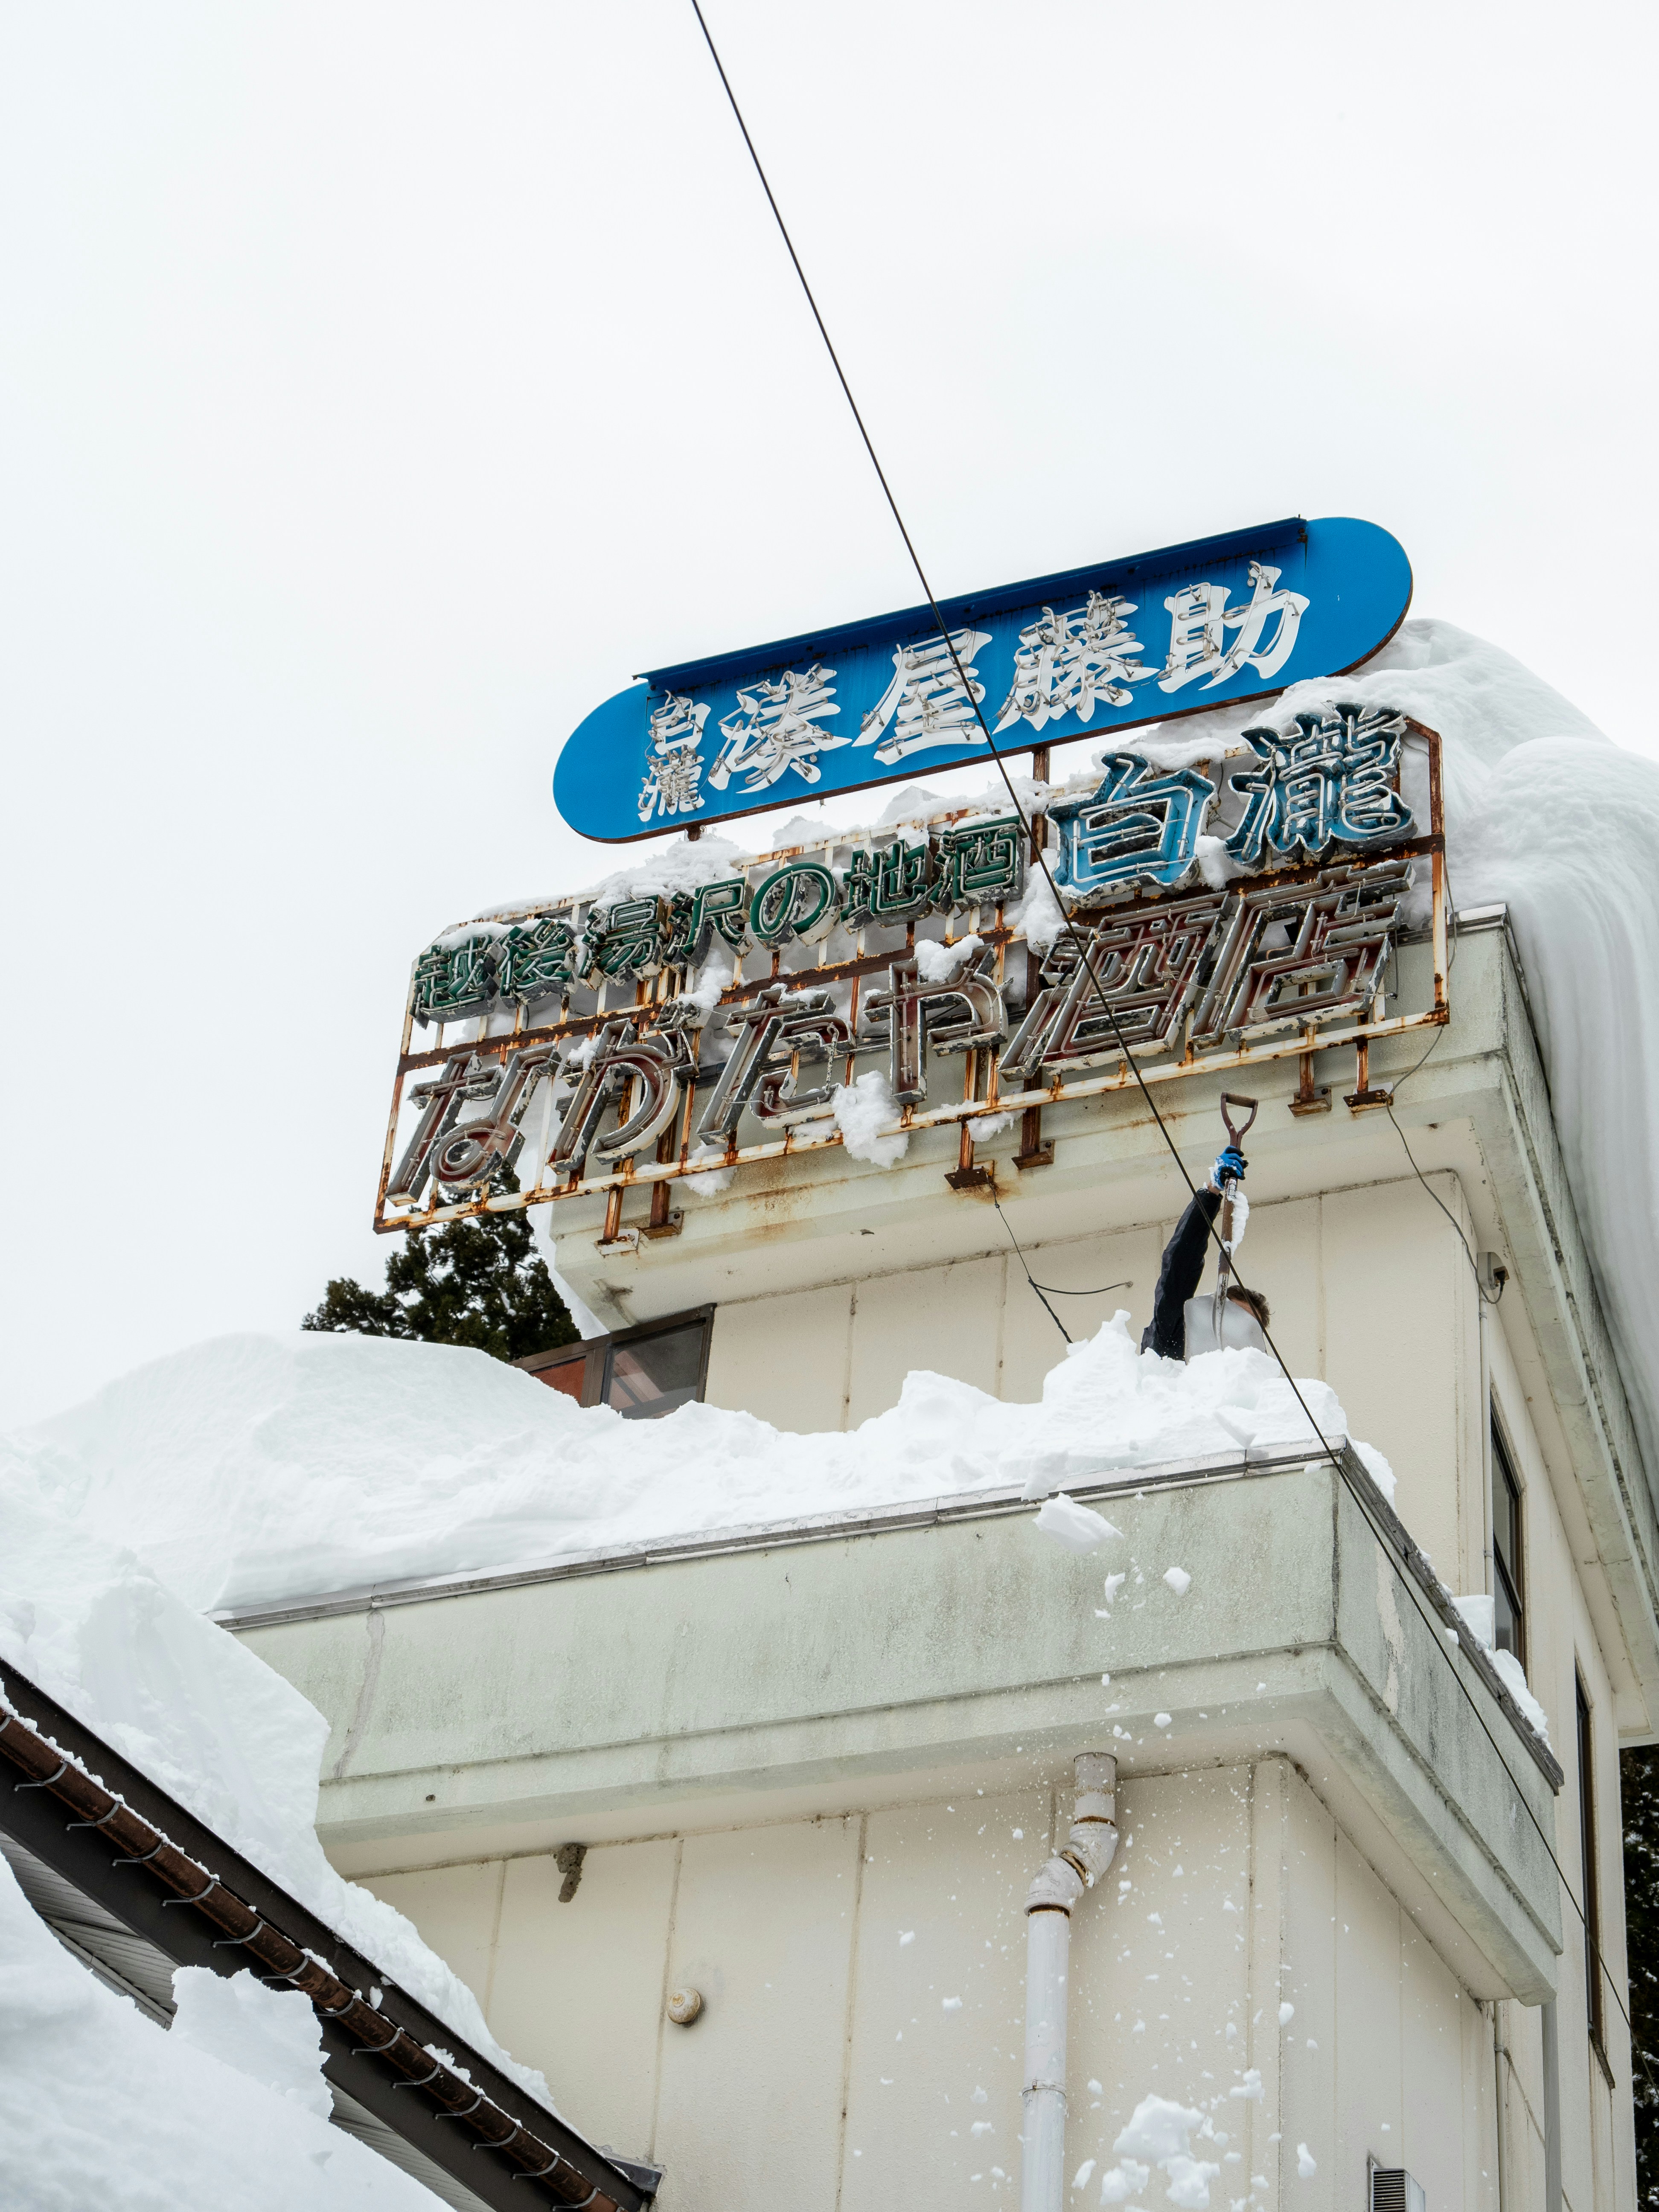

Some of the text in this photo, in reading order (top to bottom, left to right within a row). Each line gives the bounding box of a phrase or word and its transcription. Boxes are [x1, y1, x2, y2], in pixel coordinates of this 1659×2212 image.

[707, 561, 1311, 795] 湊屋藤助
[409, 702, 1417, 1028] 越後湯沢の地酒 白瀧
